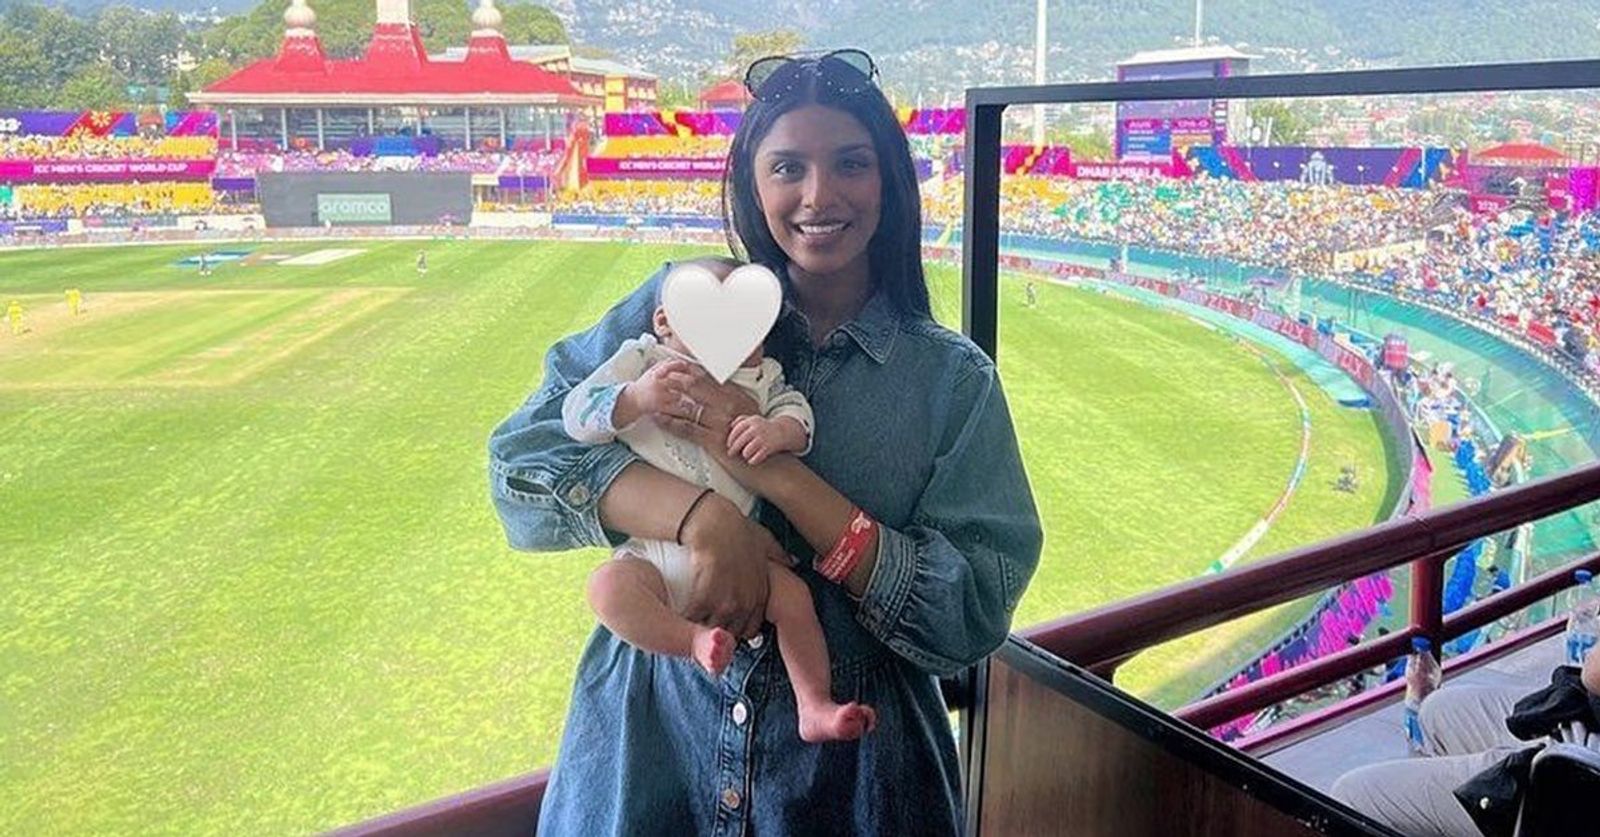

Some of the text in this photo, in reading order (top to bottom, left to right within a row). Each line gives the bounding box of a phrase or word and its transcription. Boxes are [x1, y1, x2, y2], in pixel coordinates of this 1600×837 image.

[84, 163, 127, 173] CRICKET
[128, 163, 167, 172] WORLD
[167, 163, 188, 172] CUP
[320, 201, 387, 213] aramco
